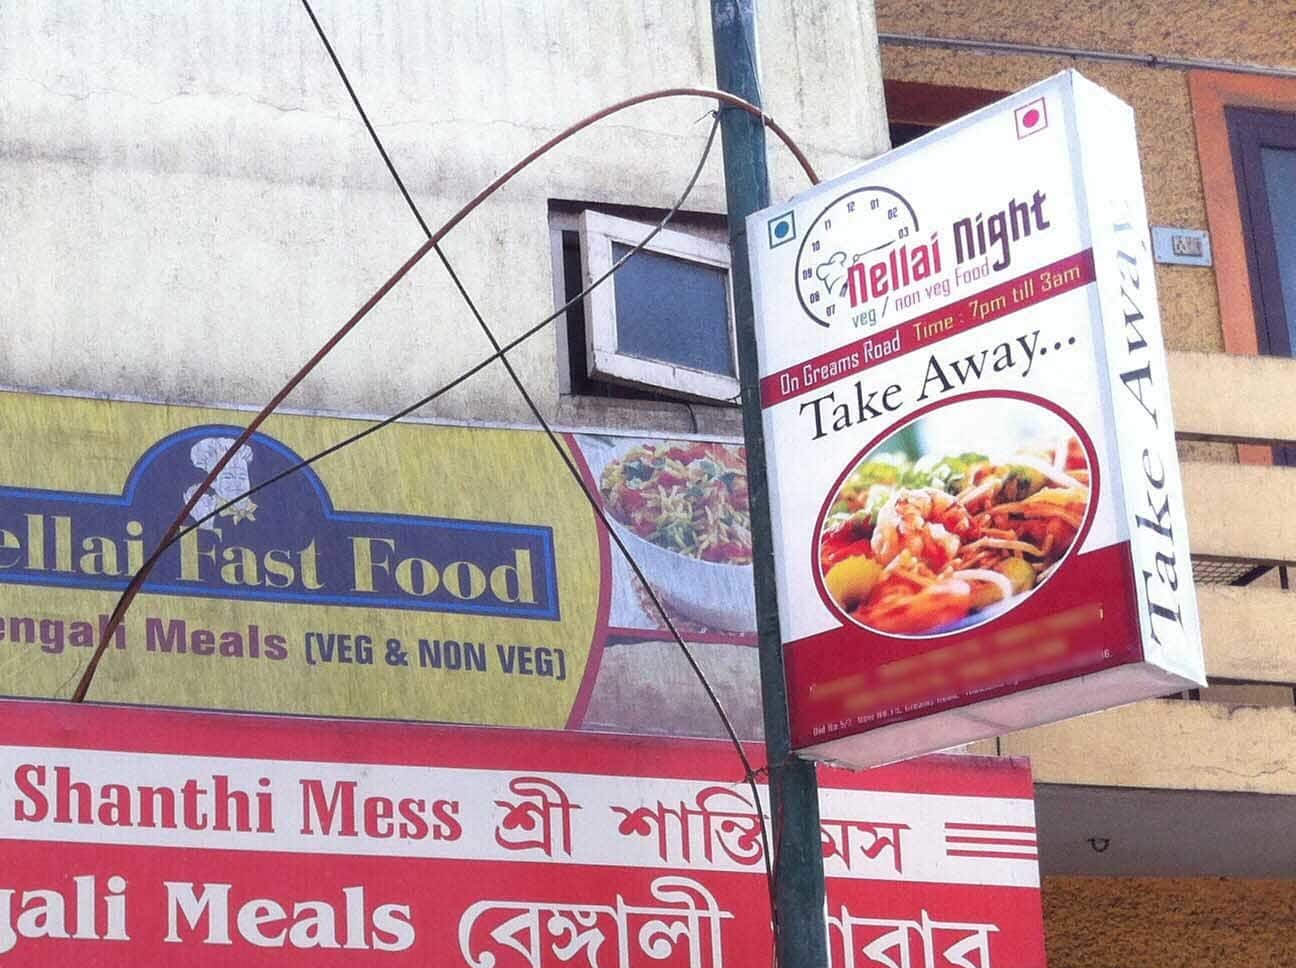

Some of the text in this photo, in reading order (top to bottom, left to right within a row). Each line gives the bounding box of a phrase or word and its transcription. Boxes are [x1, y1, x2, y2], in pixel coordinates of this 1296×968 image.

[898, 226, 909, 239] 03
[780, 373, 799, 395] On
[804, 351, 859, 386] Greams
[864, 331, 901, 363] Road
[913, 314, 953, 341] Time
[969, 294, 1006, 320] 7pm
[1012, 279, 1034, 302] till
[1040, 264, 1081, 293] 3am
[852, 308, 876, 328] veg
[895, 291, 920, 311] non
[925, 279, 950, 298] veg
[799, 330, 1076, 441] Take Away...
[175, 526, 323, 590] Fast
[349, 535, 542, 605] Food
[1135, 447, 1183, 648] Take
[144, 618, 290, 660] Meals
[385, 638, 408, 667] &
[418, 639, 487, 672] NON
[14, 763, 275, 834] Shanthi
[299, 778, 463, 843] Mess
[494, 776, 582, 857] শ্রী
[609, 785, 766, 866] শান্তি
[163, 881, 417, 952] Meals
